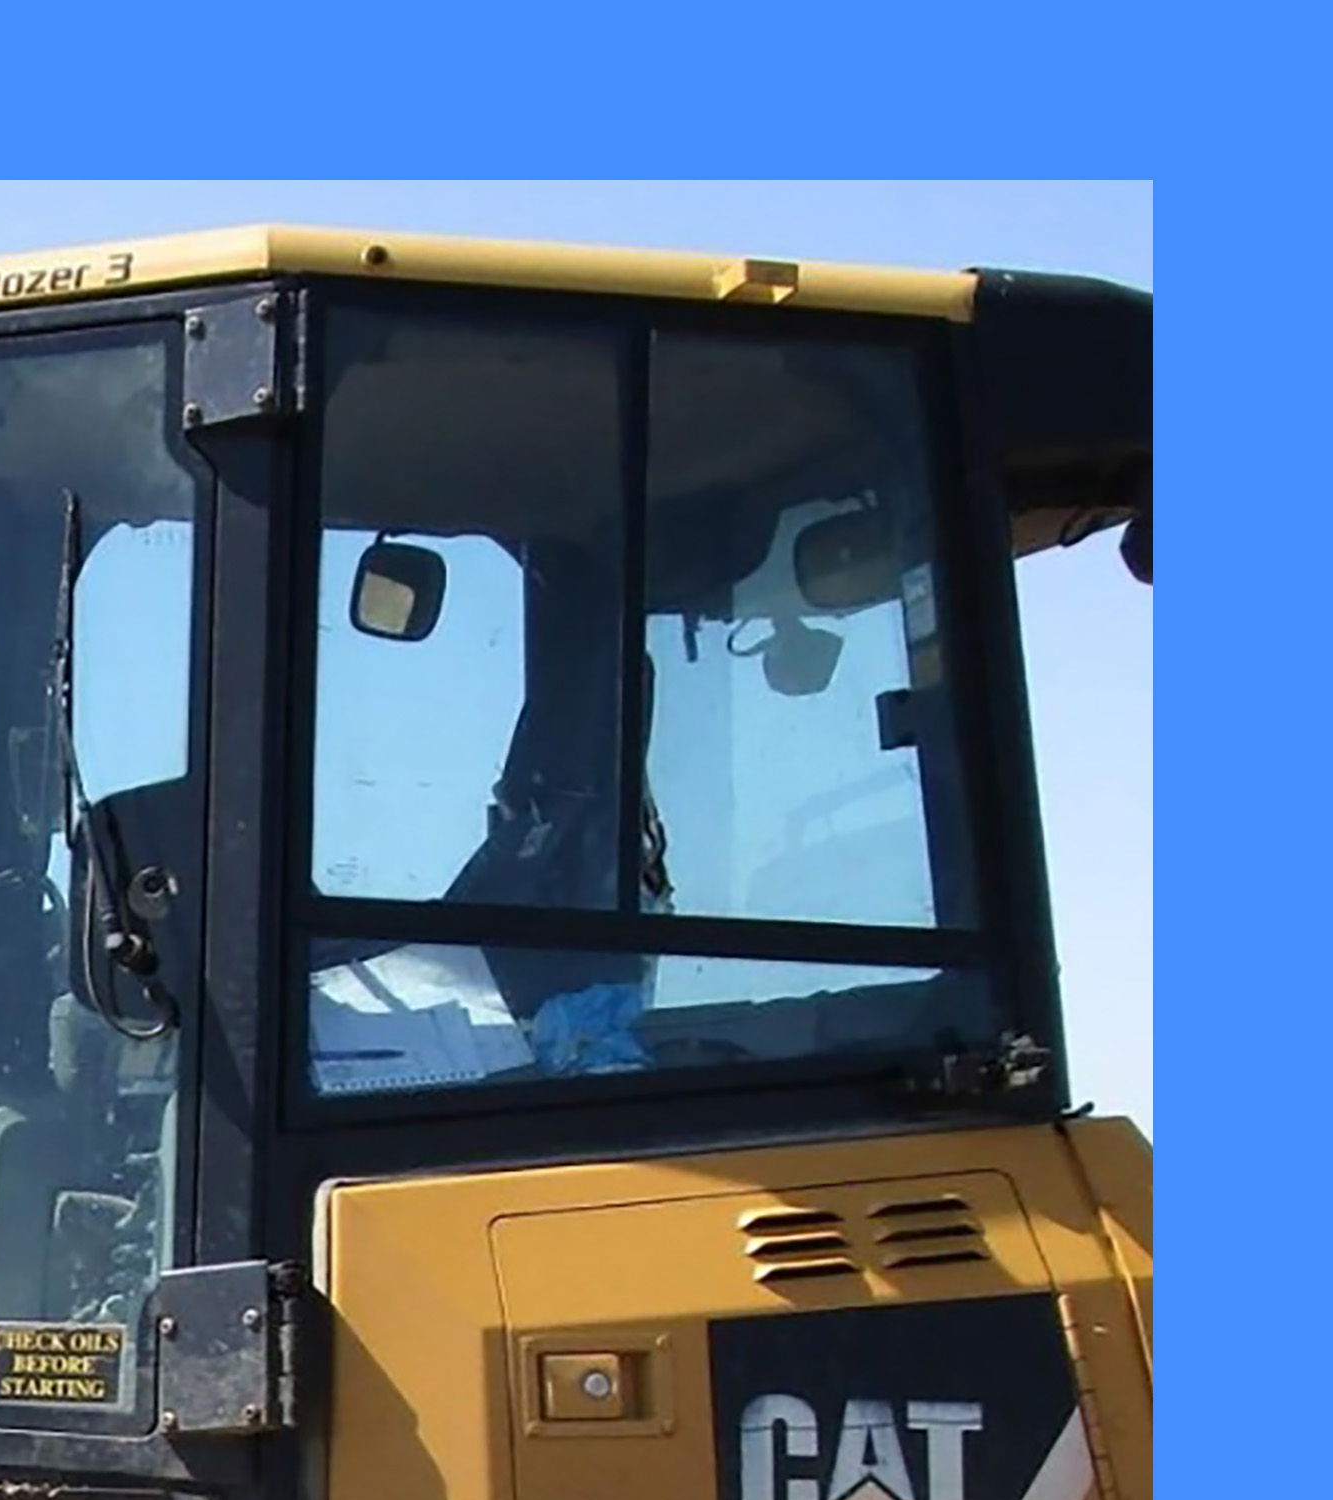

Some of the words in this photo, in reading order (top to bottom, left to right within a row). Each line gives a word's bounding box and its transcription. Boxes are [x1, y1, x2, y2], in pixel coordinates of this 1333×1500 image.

[104, 252, 134, 285] 3
[70, 1332, 120, 1353] OILS
[12, 1354, 97, 1375] BEFORE
[0, 1376, 106, 1399] STARTING
